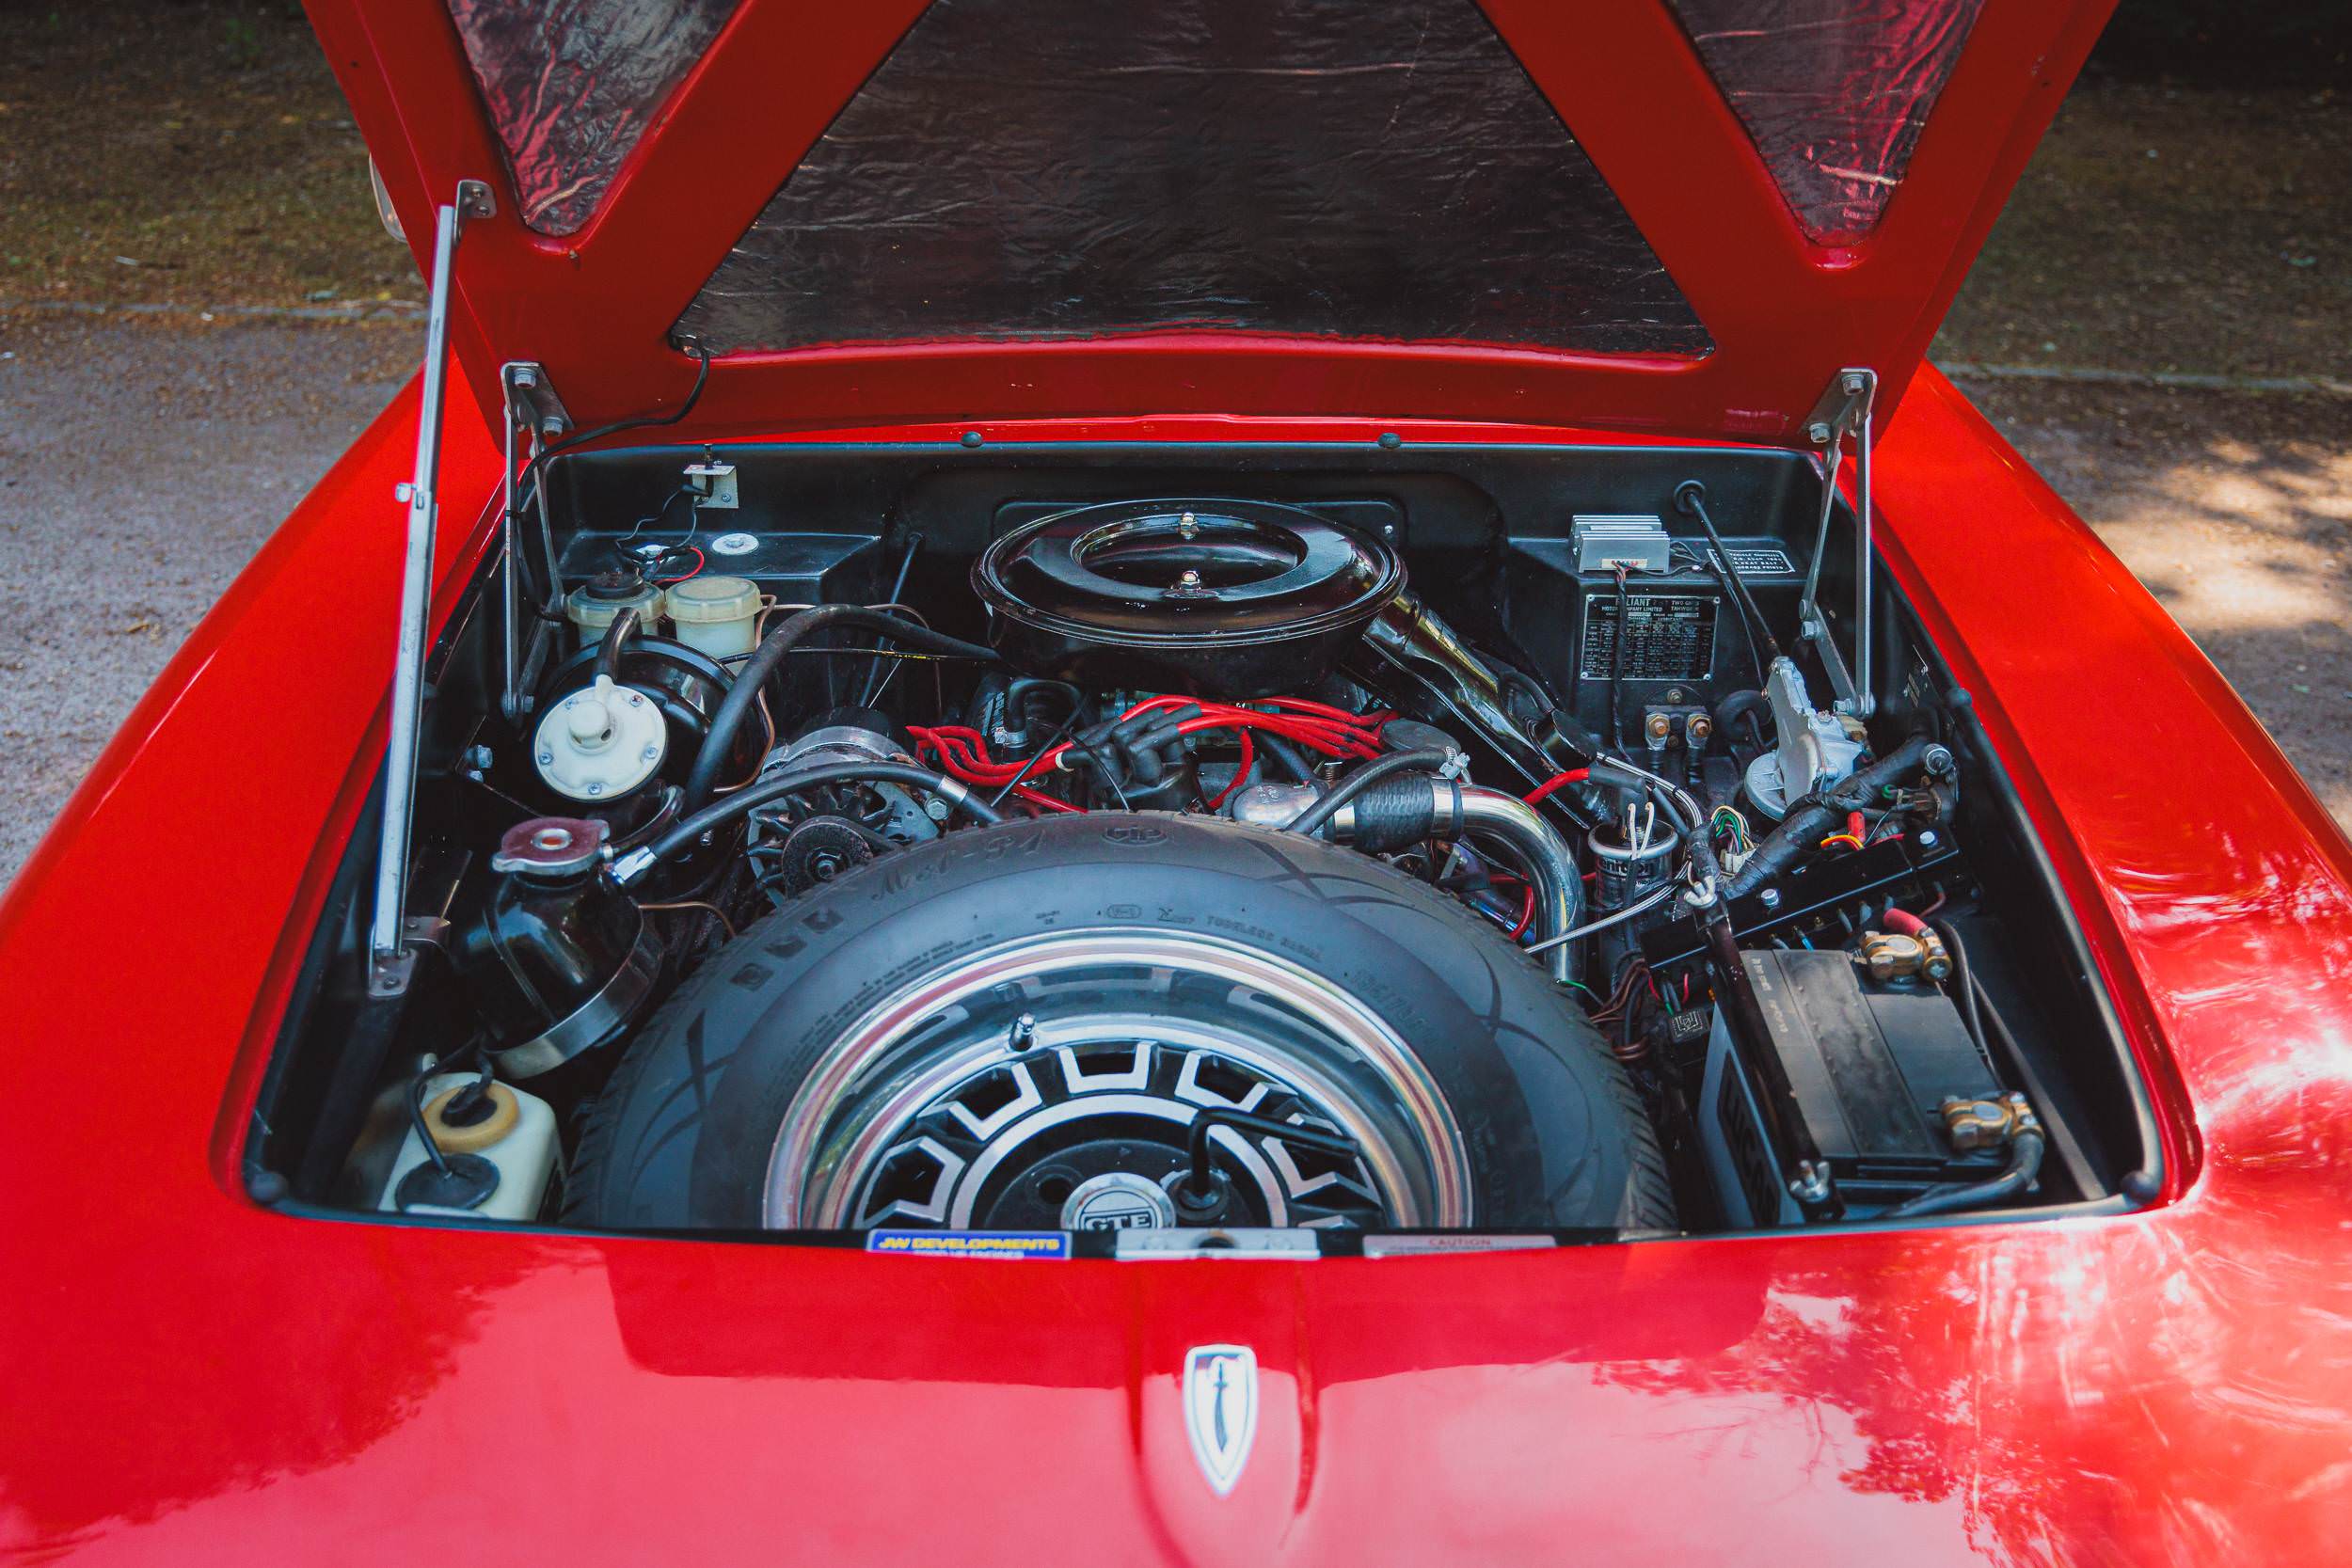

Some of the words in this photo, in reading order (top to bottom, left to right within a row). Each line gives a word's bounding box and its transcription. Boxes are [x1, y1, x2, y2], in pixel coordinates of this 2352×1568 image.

[1084, 1212, 1151, 1230] GTE
[879, 1237, 911, 1249] JW
[912, 1237, 1060, 1250] DEVELOPMENTS
[1428, 1238, 1491, 1246] CAUTION
